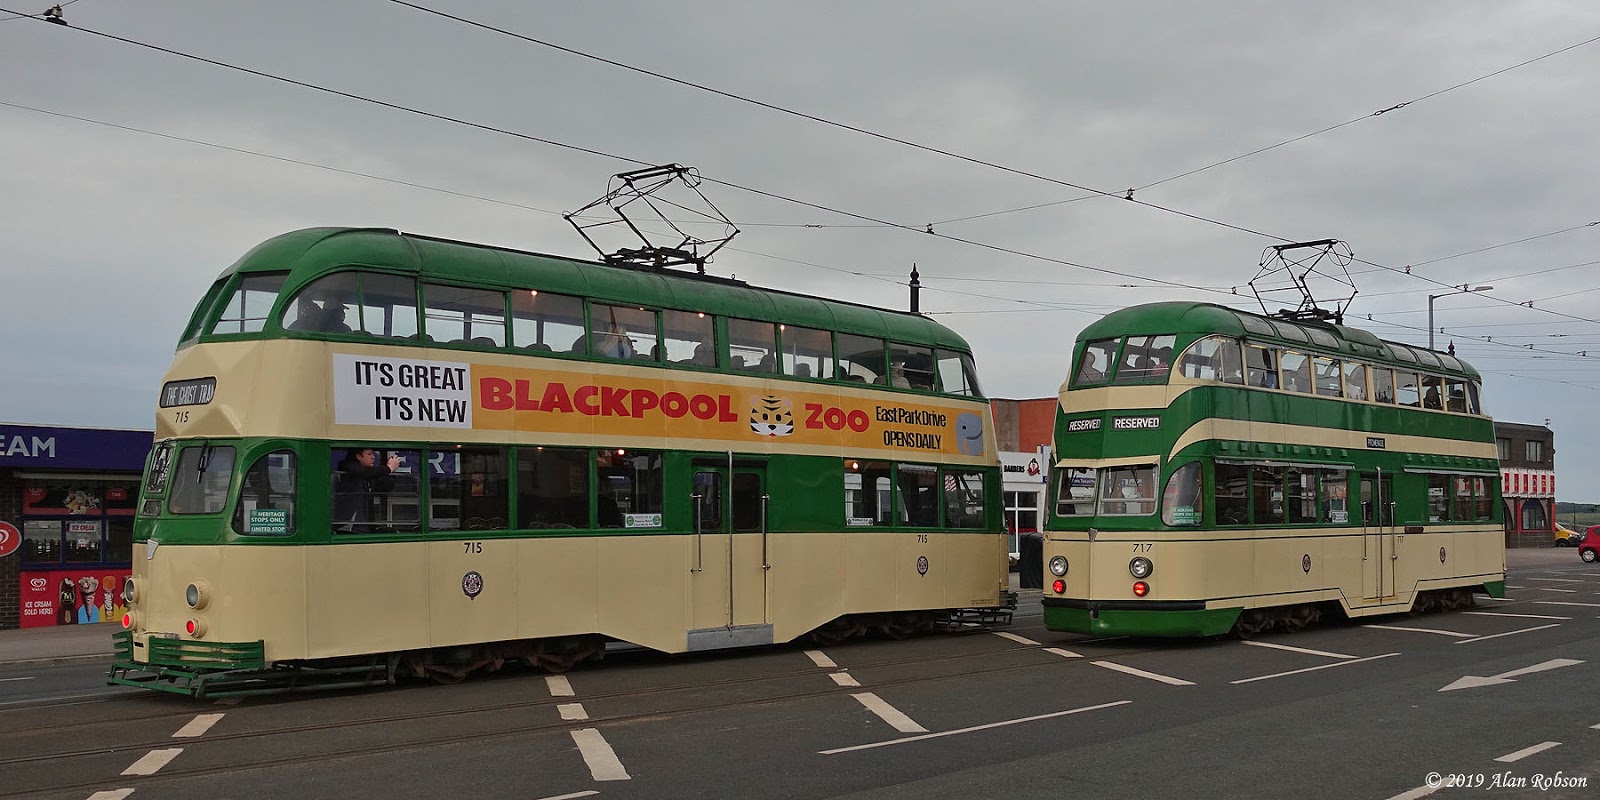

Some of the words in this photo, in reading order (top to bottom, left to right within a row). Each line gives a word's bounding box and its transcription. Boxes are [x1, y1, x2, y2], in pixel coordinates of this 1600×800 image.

[355, 361, 394, 387] IT'S
[399, 364, 466, 390] GREAT
[166, 387, 178, 406] THE
[375, 396, 413, 421] IT'S
[418, 398, 467, 423] NEW
[480, 377, 738, 422] BLACKPOOL
[805, 403, 870, 432] ZOO
[175, 411, 189, 423] 715
[876, 405, 898, 423] East
[898, 408, 922, 425] Park
[922, 410, 946, 427] Drive
[1068, 418, 1101, 431] RESERVED
[1114, 417, 1160, 429] RESERVED
[883, 430, 915, 448] OPENS
[915, 432, 941, 449] DAILY
[1003, 464, 1025, 473] BARBERS
[917, 534, 928, 543] 715
[463, 542, 482, 554] 715
[1132, 543, 1153, 553] 717
[24, 608, 38, 616] SOLD
